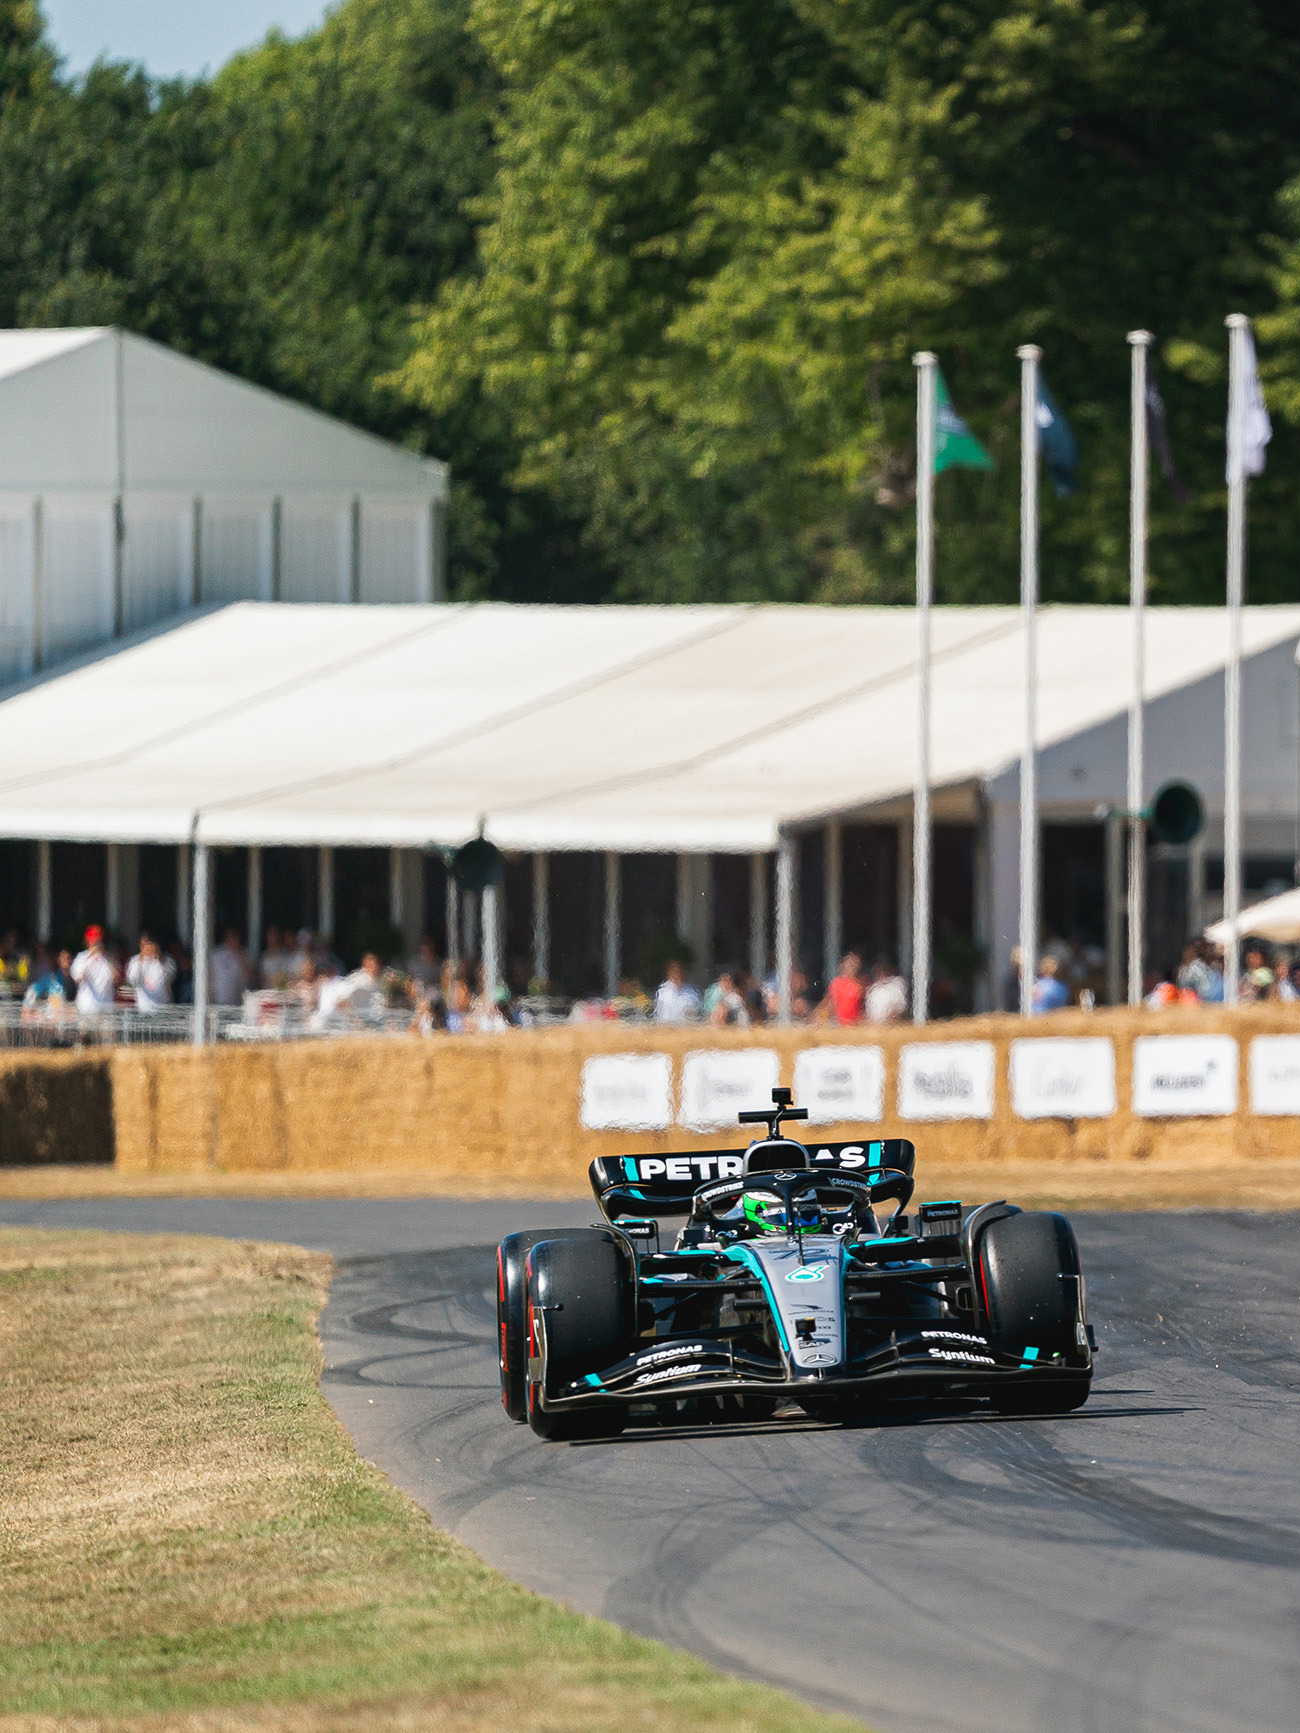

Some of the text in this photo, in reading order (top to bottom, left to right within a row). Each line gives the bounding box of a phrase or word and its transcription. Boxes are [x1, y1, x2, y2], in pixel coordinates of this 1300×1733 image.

[639, 1146, 867, 1181] PETRAS
[921, 1331, 988, 1344] PETRONAS
[636, 1344, 703, 1366] PETRONAS
[928, 1348, 996, 1365] Syntium
[633, 1363, 702, 1386] Syntium
